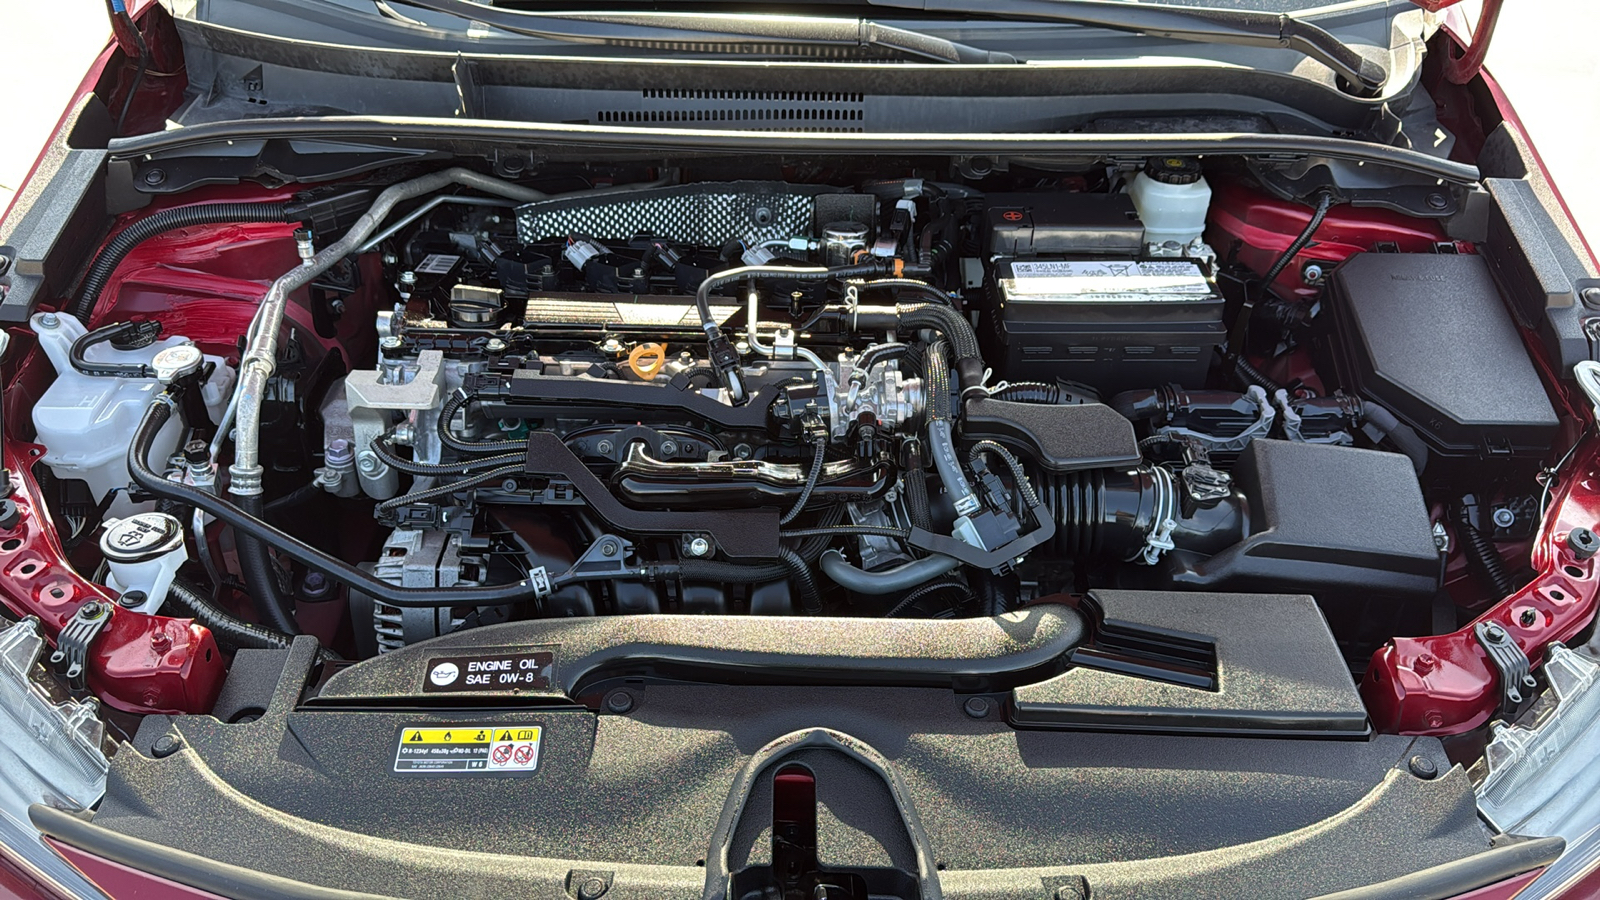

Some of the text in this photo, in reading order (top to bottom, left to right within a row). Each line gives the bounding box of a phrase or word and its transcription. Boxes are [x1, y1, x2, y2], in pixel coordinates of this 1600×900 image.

[467, 658, 539, 672] ENGINE OIL
[465, 672, 534, 684] SAE 0W-8
